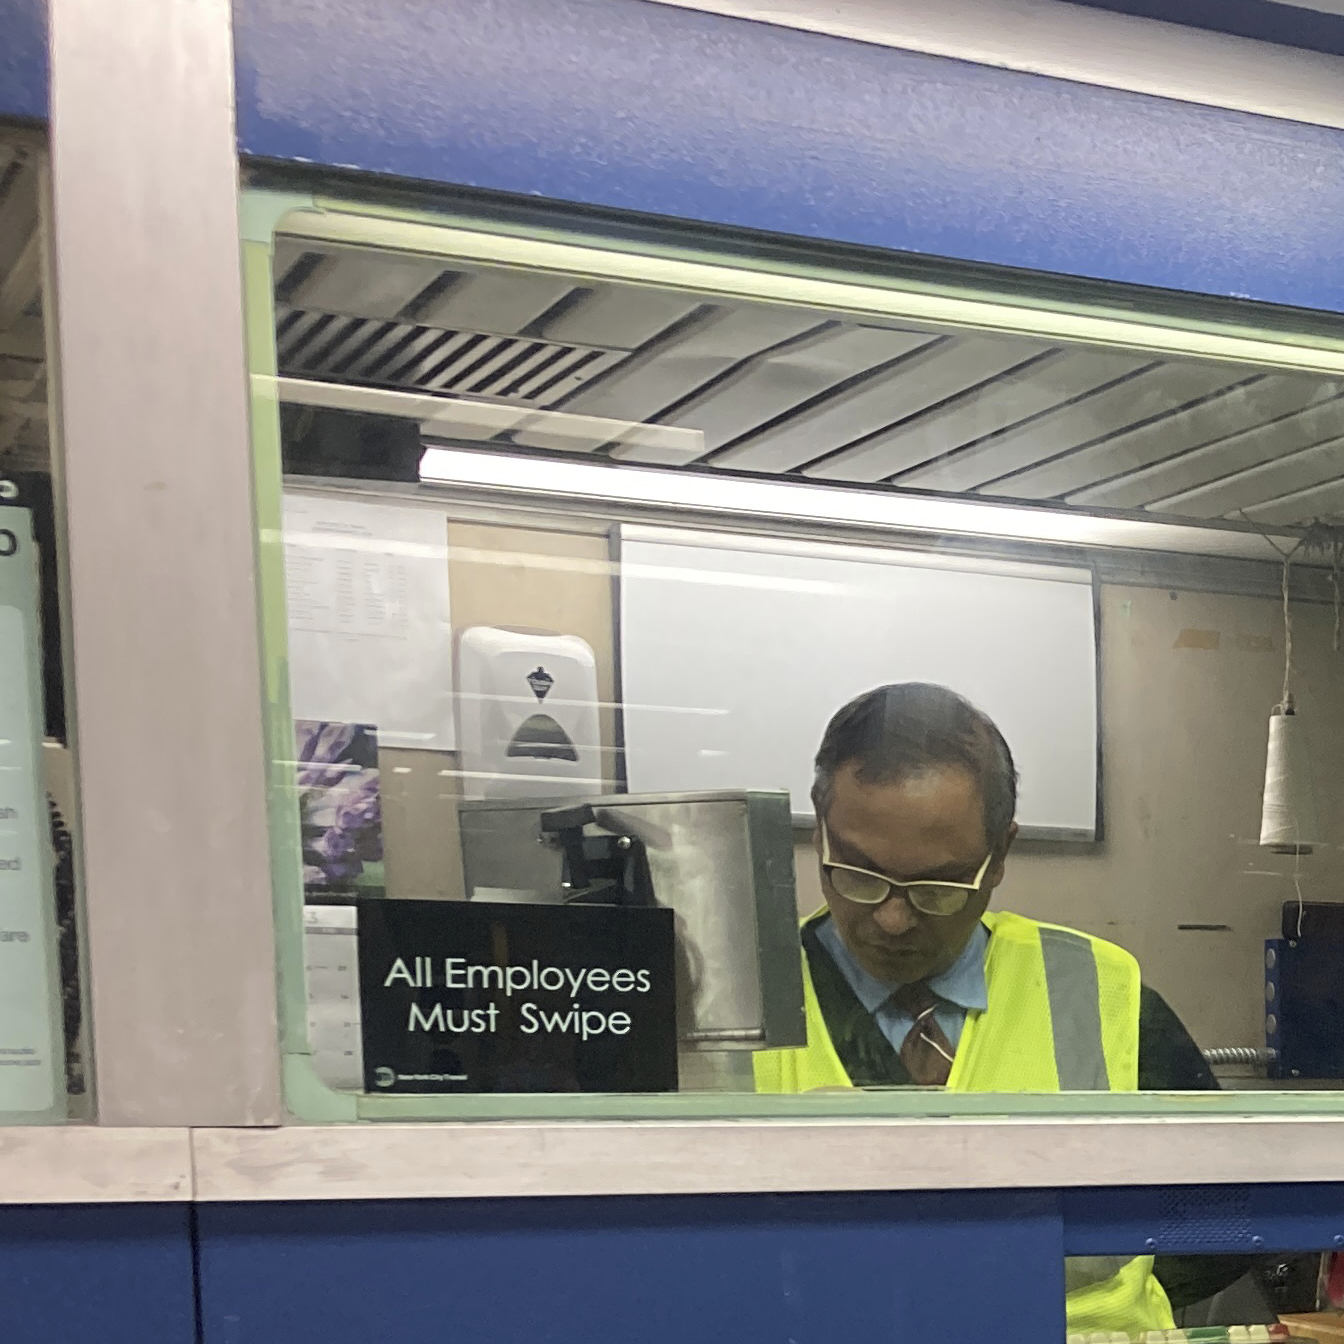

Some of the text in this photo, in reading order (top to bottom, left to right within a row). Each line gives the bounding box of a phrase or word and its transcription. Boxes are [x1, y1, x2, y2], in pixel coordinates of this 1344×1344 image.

[384, 956, 651, 998] All Employees
[407, 1001, 632, 1041] Must Swipe
